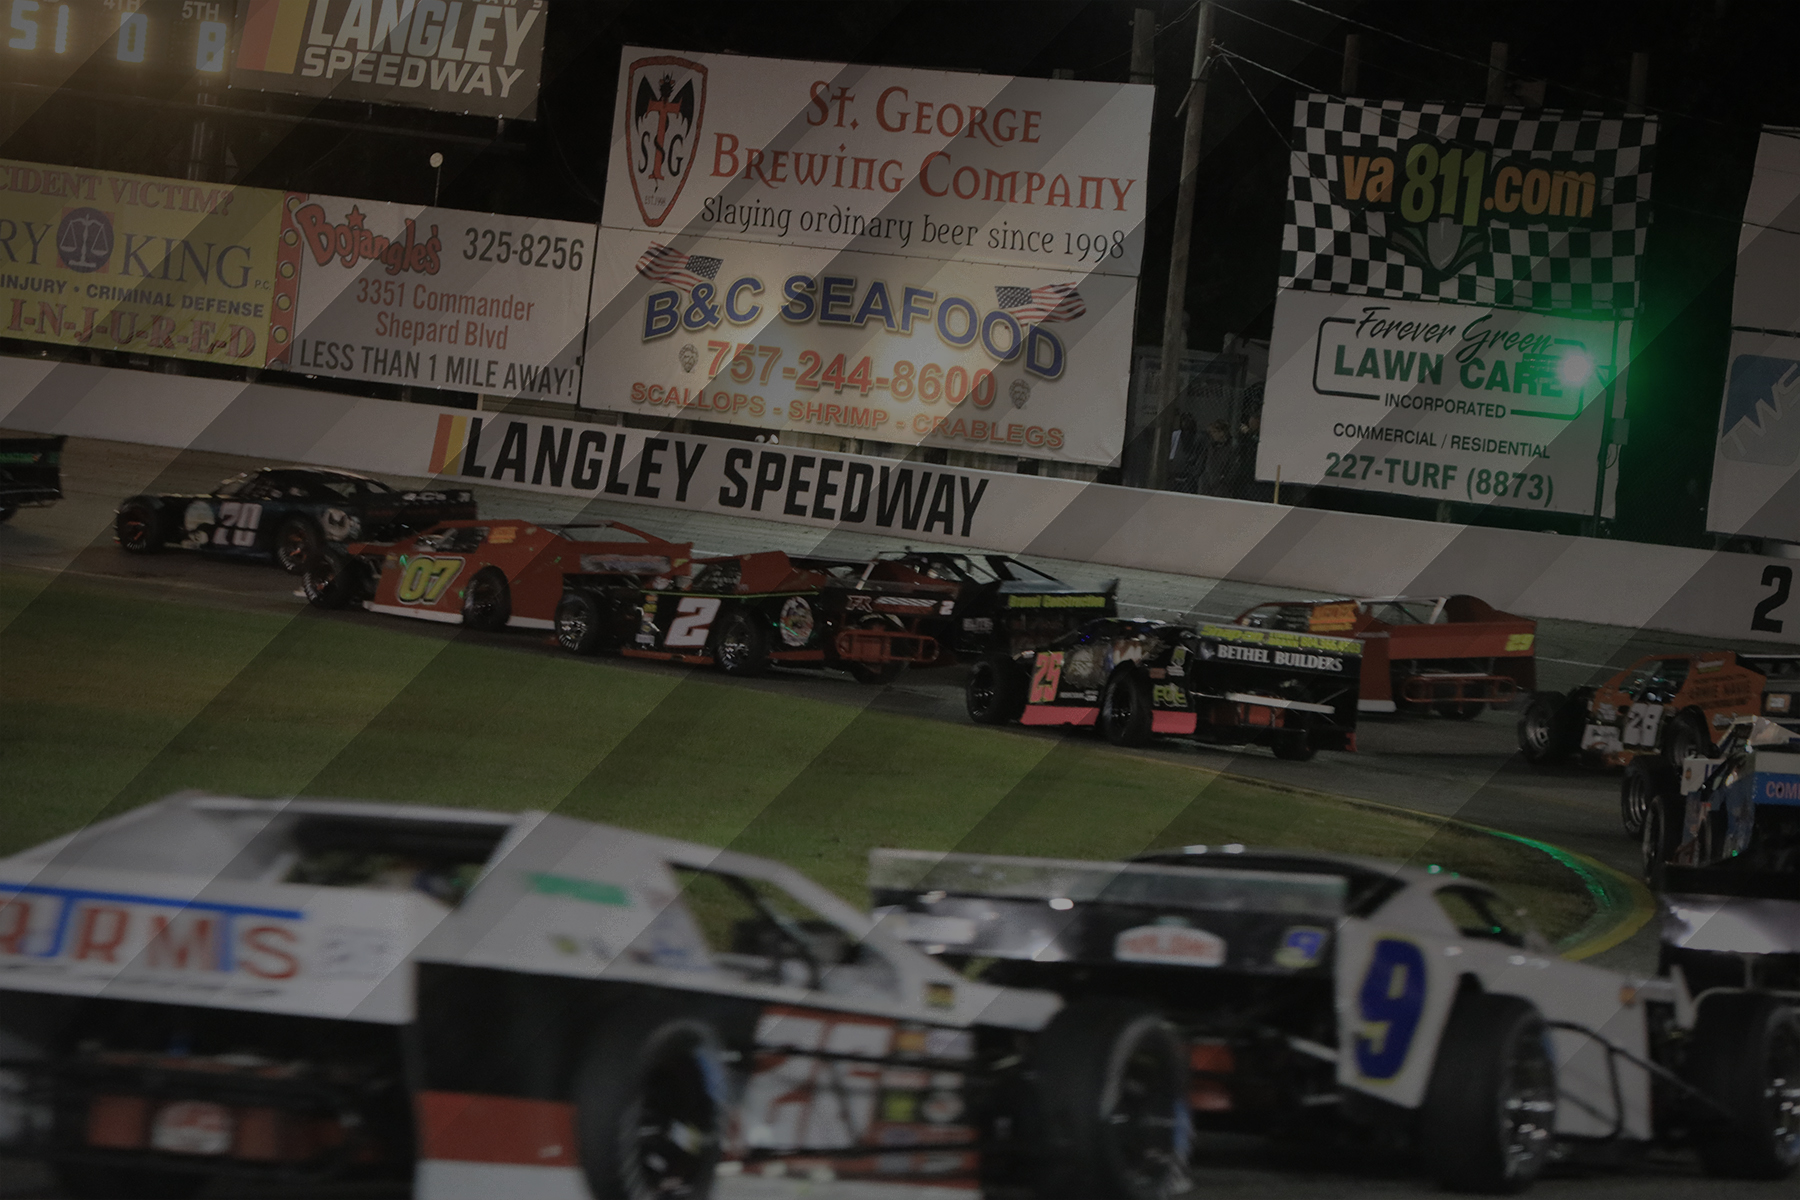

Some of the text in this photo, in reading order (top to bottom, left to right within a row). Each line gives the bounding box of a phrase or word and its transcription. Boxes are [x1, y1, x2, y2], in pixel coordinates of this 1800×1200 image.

[182, 1, 220, 21] 5TH
[307, 0, 540, 67] LANGLEY
[301, 46, 525, 98] SPEEDWAY
[876, 86, 1042, 148] GEORGE
[108, 176, 235, 217] VICTIM?
[919, 150, 1136, 211] COMPANY
[462, 227, 585, 272] 325-8256
[701, 195, 1125, 263] Slaying ordinary beer since 1998
[119, 233, 254, 289] KING
[0, 274, 264, 317] INJURY CRIMINAL DEFENSE
[356, 277, 535, 321] 3351 Commander
[375, 311, 509, 350] Shepard Blvd
[643, 274, 1066, 379] B&C SEAFOOD
[1355, 306, 1552, 363] Forever Green
[300, 339, 575, 397] LESS THAN 1 MILE AWAY!
[706, 340, 997, 408] 757-244-8600
[1334, 345, 1444, 385] LAWN
[630, 382, 766, 416] SCALLOPS
[788, 399, 889, 431] SHRIMP
[912, 413, 1065, 448] CRABLEGS
[1384, 393, 1506, 418] INCORPORATED
[1333, 423, 1438, 447] COMMERCIAL
[1450, 435, 1551, 459] RESIDENTIAL
[461, 416, 989, 537] LANGLEY SPEEDWAY
[1324, 452, 1553, 507] 227-TURF (8873)
[396, 555, 465, 605] 07
[1751, 565, 1793, 633] 2
[663, 598, 722, 648] 2
[939, 600, 956, 616] 2
[1217, 644, 1344, 672] BETHEL BUILDERS
[1623, 702, 1664, 747] 28
[1356, 937, 1427, 1083] 9
